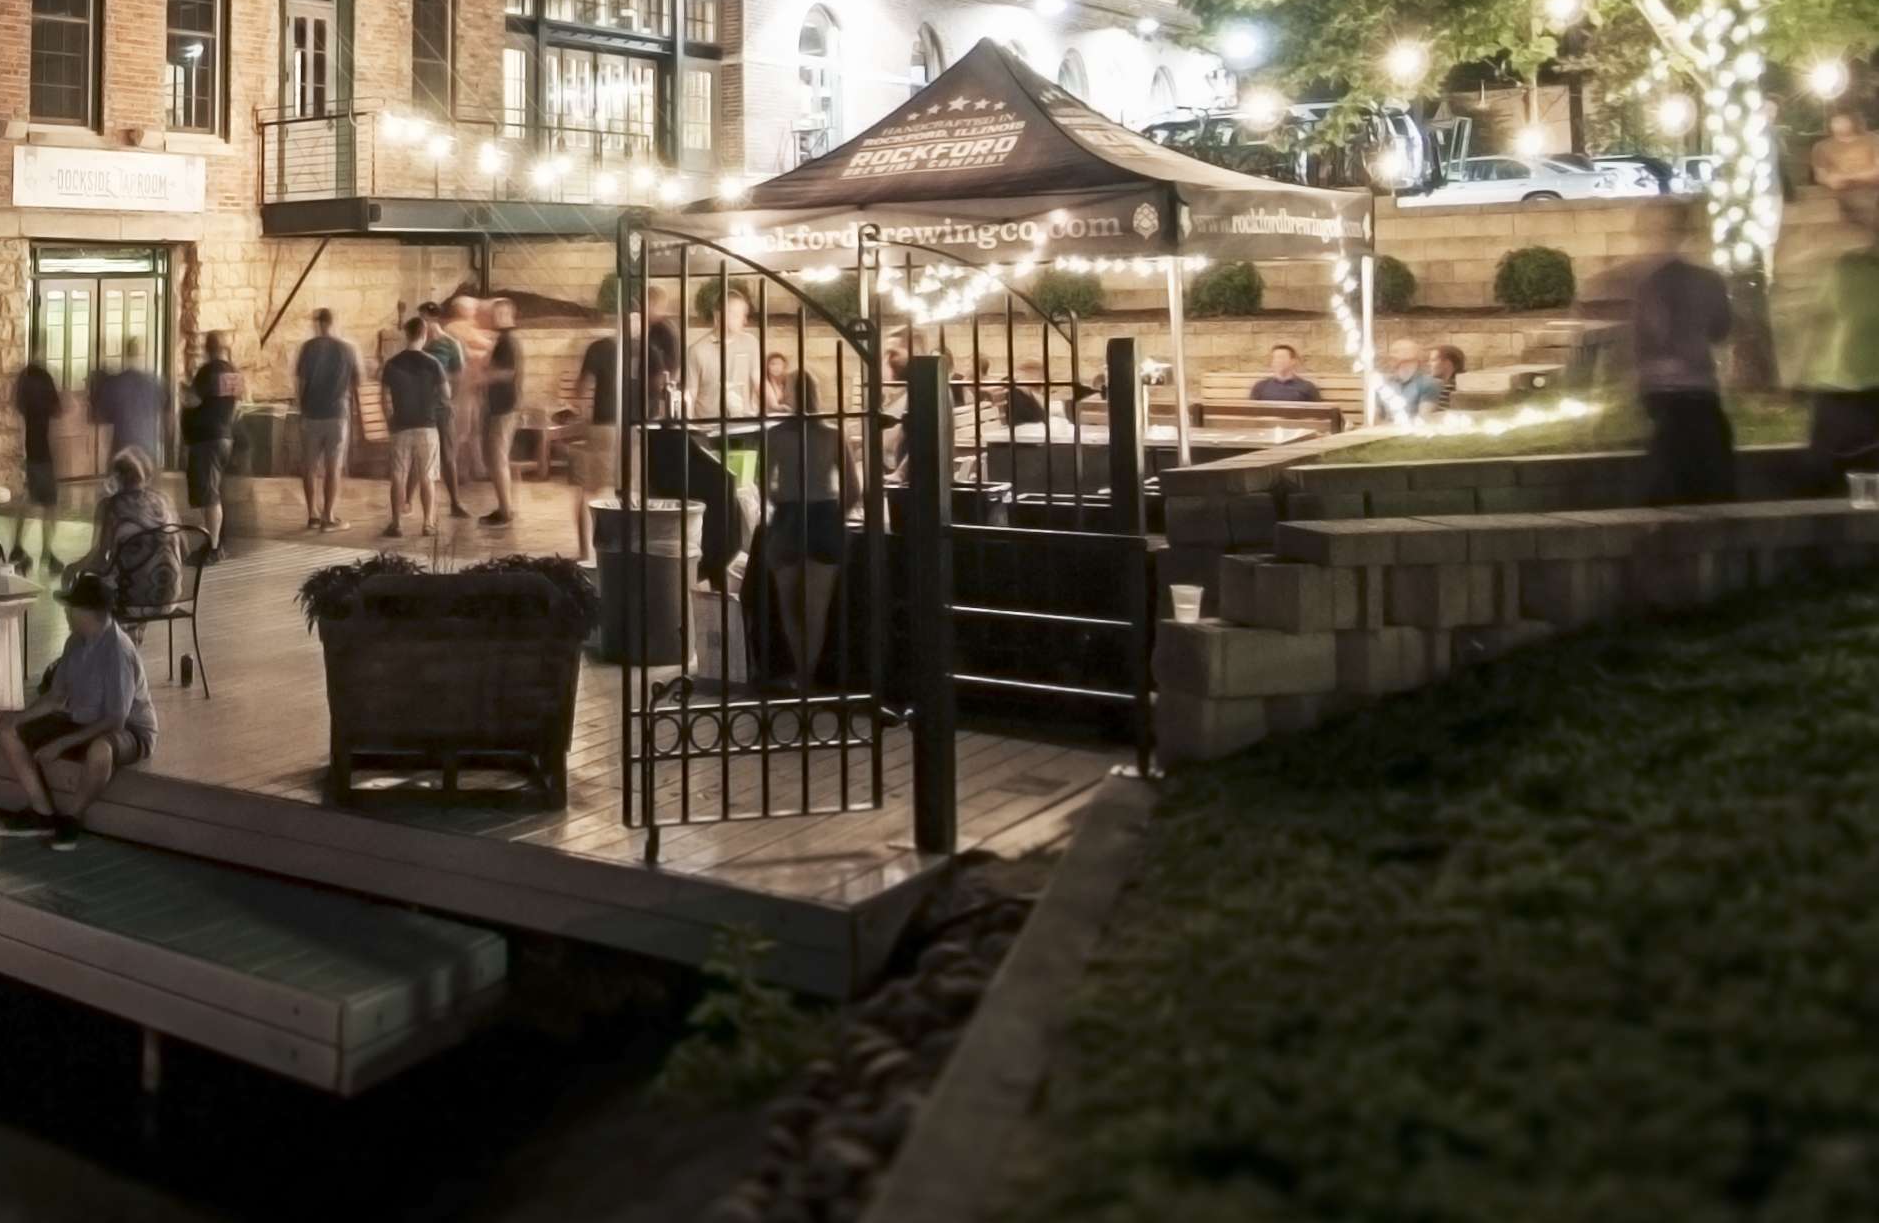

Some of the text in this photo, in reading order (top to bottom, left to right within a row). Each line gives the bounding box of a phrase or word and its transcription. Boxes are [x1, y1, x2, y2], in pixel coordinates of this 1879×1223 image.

[882, 116, 995, 136] HANDCRAFTED
[954, 121, 1026, 137] ILLINOIS
[849, 135, 1019, 168] ROCKFORD
[842, 152, 1009, 177] BREWING COMPANY
[57, 166, 168, 199] DOCKSIDE TAPROOM
